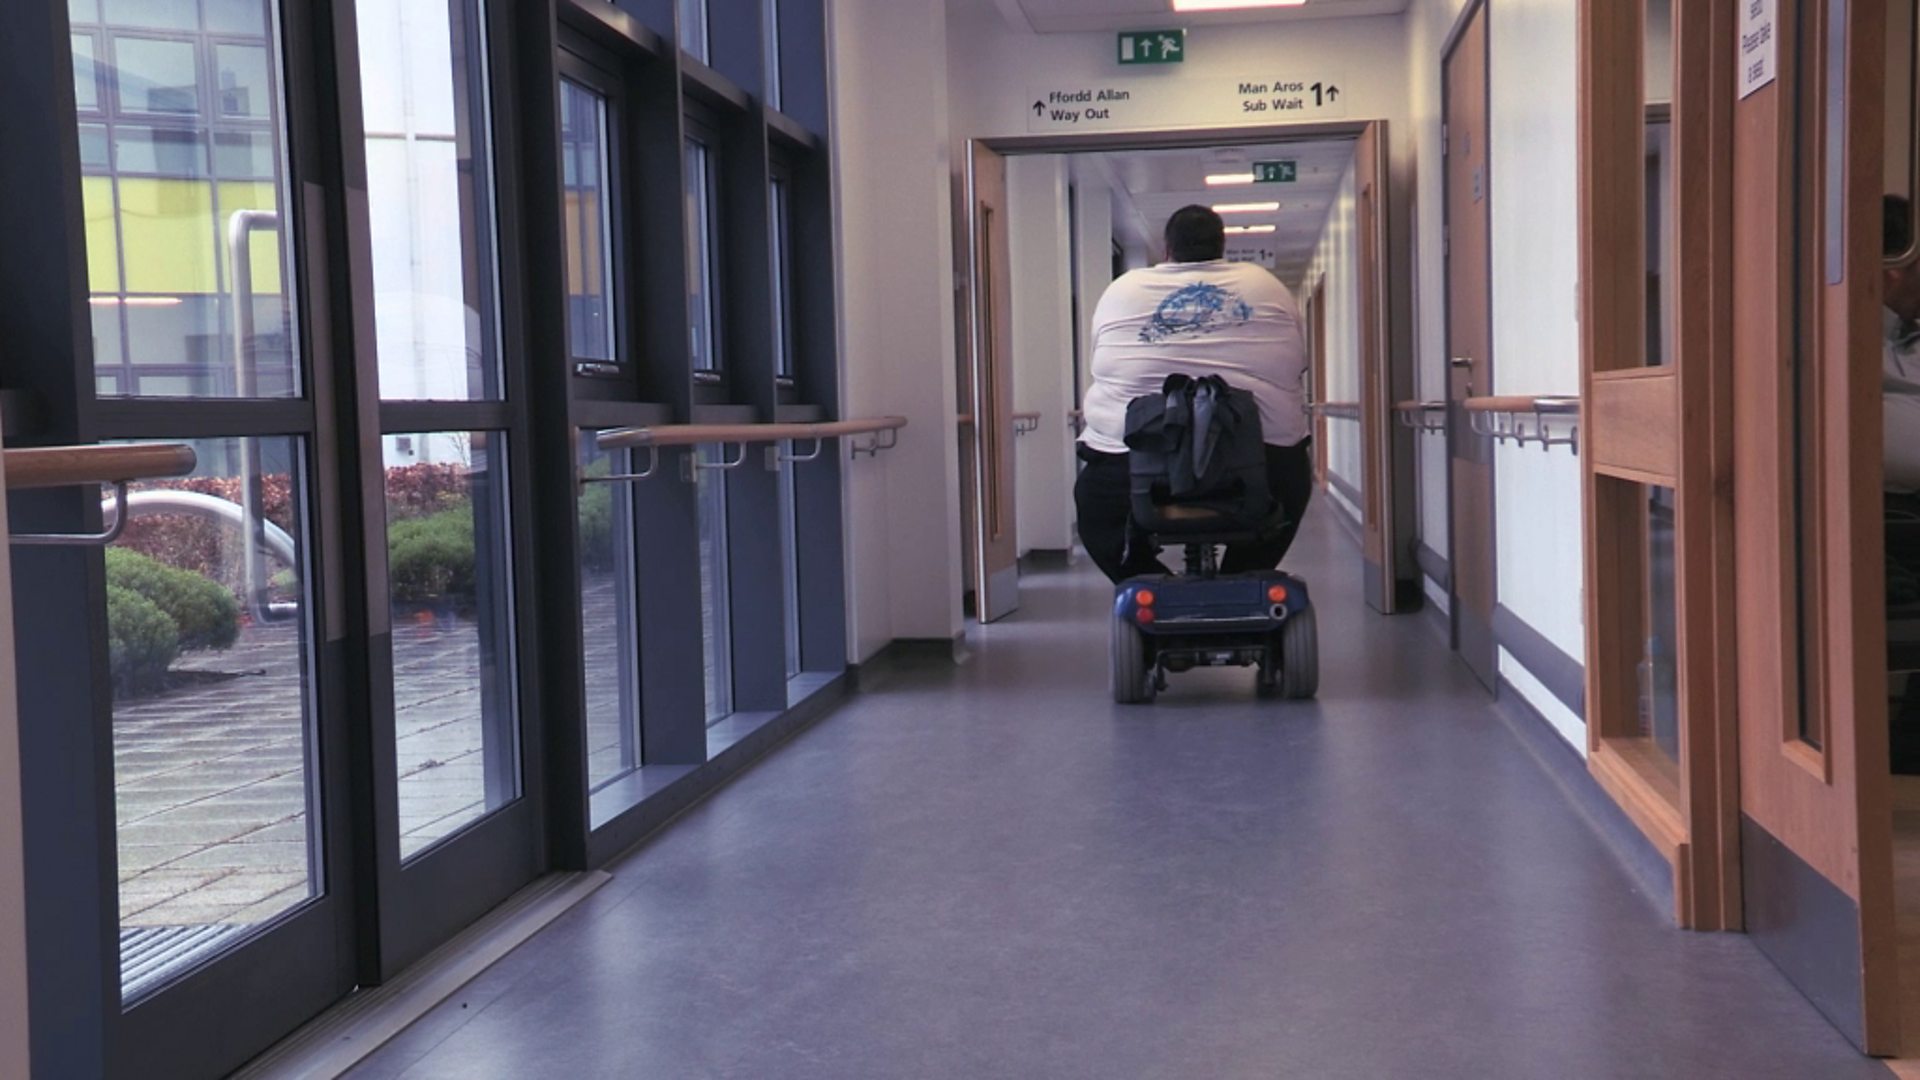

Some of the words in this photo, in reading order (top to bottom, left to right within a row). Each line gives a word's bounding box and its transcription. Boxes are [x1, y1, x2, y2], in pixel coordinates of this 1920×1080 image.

[1238, 83, 1268, 94] Man
[1273, 81, 1304, 92] Aros
[1310, 82, 1322, 106] 1
[1049, 90, 1092, 103] Ffordd
[1096, 89, 1130, 102] Allan
[1242, 99, 1267, 112] Sub
[1272, 98, 1304, 110] Wait
[1050, 109, 1080, 123] Way
[1084, 108, 1110, 119] Out
